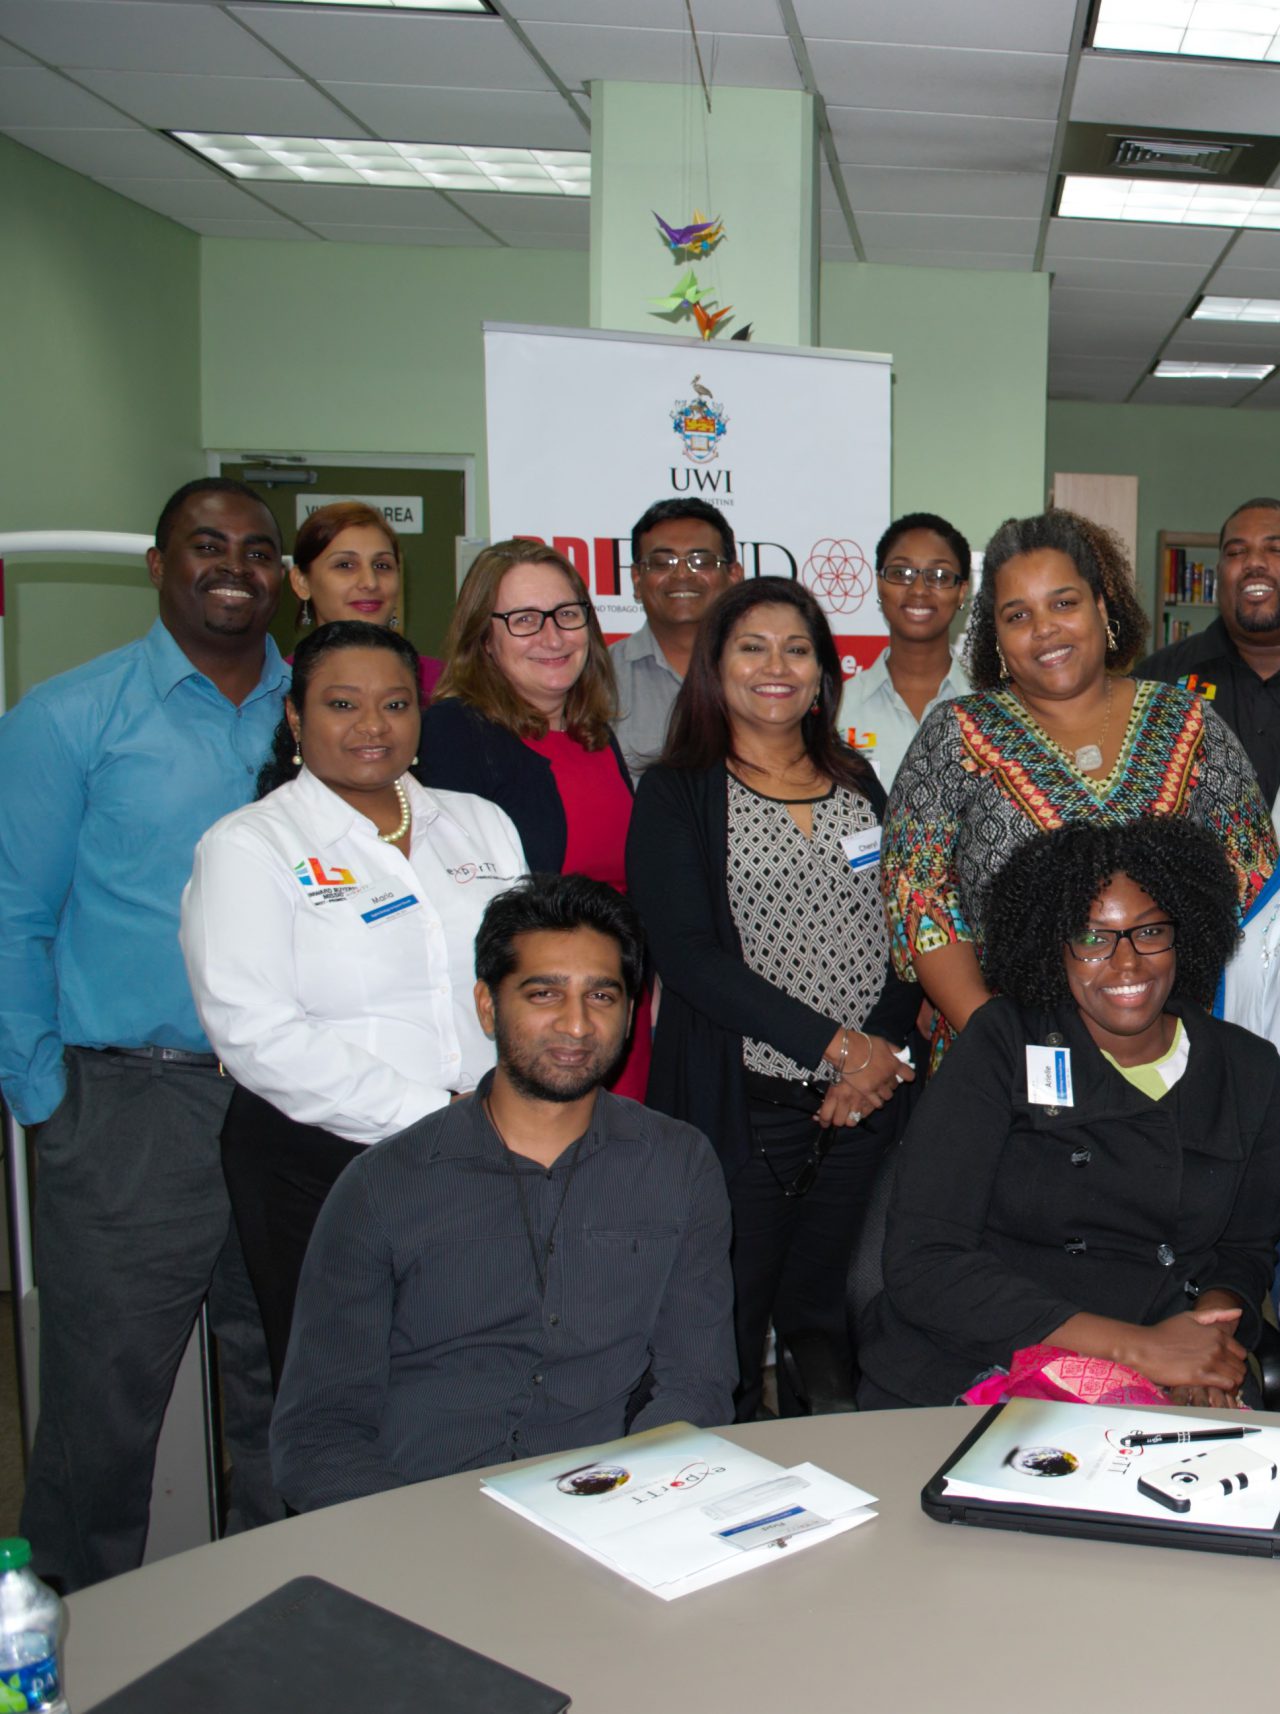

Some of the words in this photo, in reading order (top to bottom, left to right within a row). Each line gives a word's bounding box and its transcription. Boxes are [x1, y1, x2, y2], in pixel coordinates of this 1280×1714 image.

[669, 467, 734, 493] UWI
[377, 506, 414, 522] REA
[607, 604, 637, 614] TOBAGO
[371, 890, 395, 905] Maria
[1044, 1065, 1052, 1088] Arielle
[631, 1465, 728, 1505] exporTT
